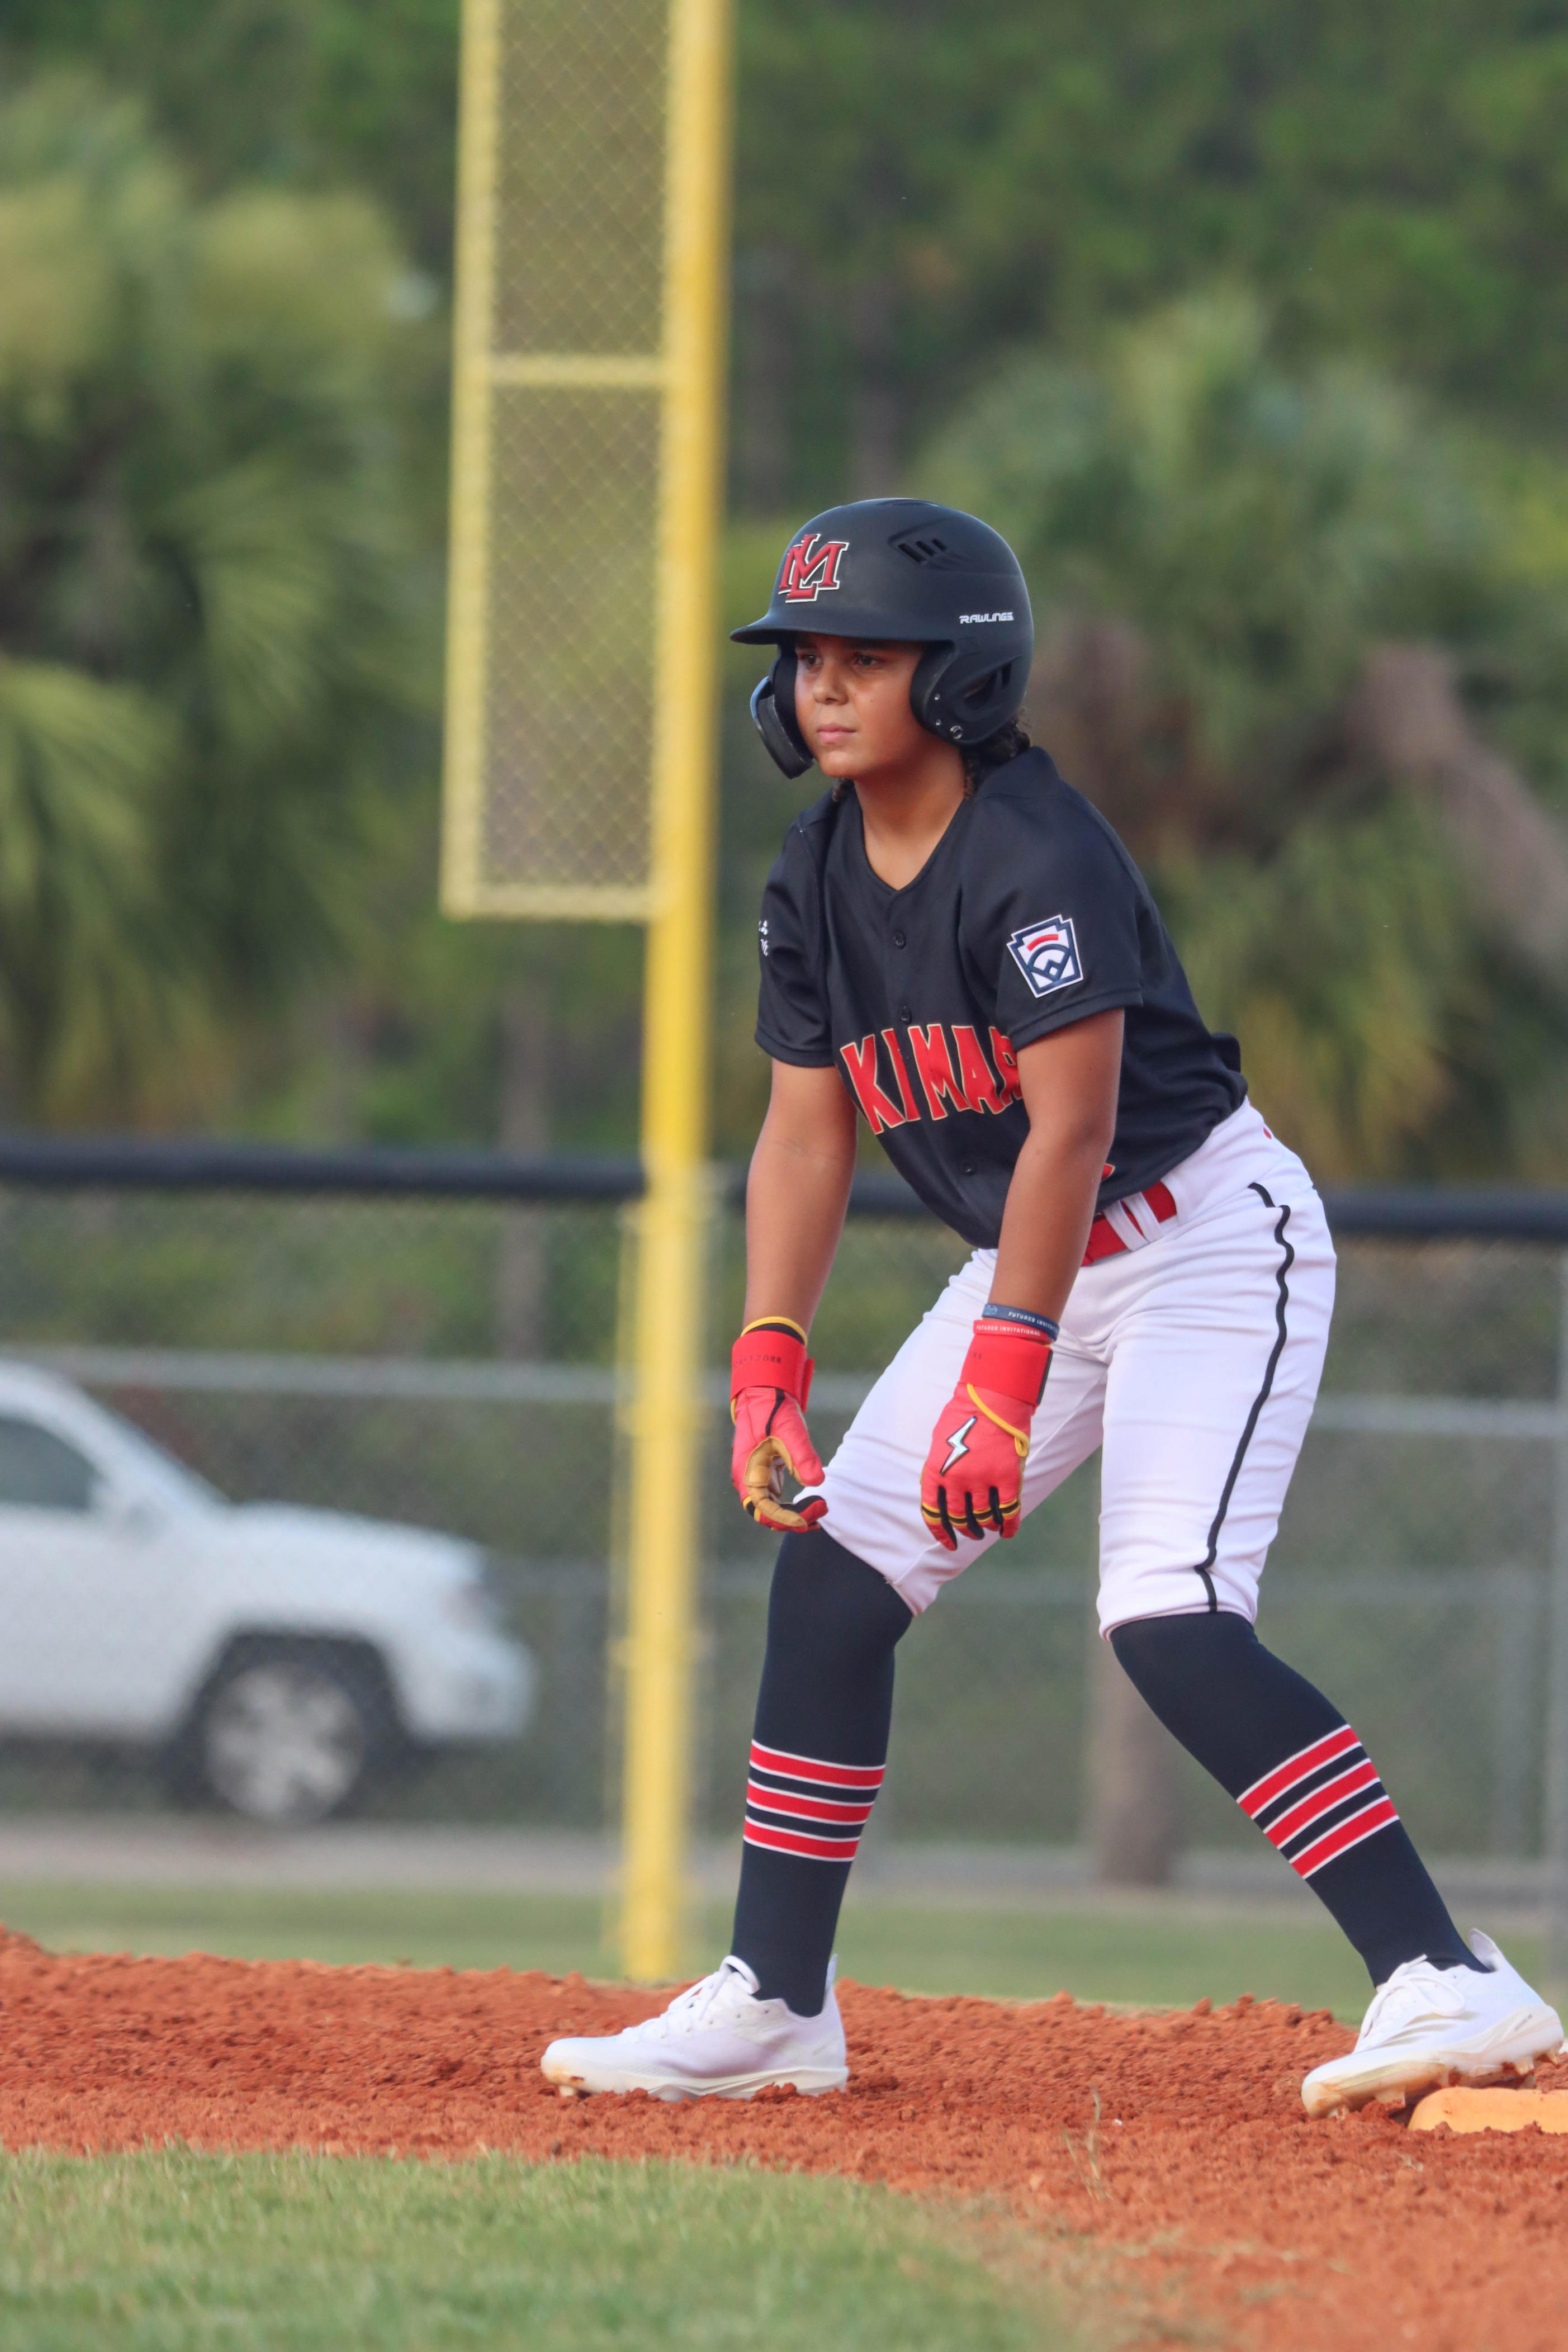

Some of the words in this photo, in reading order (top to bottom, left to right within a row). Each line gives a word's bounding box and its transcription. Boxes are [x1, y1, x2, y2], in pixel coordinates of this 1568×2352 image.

[959, 612, 1014, 624] RAWLINGS
[1008, 1311, 1035, 1323] FUTURES
[999, 1326, 1041, 1336] INVITATIONAL
